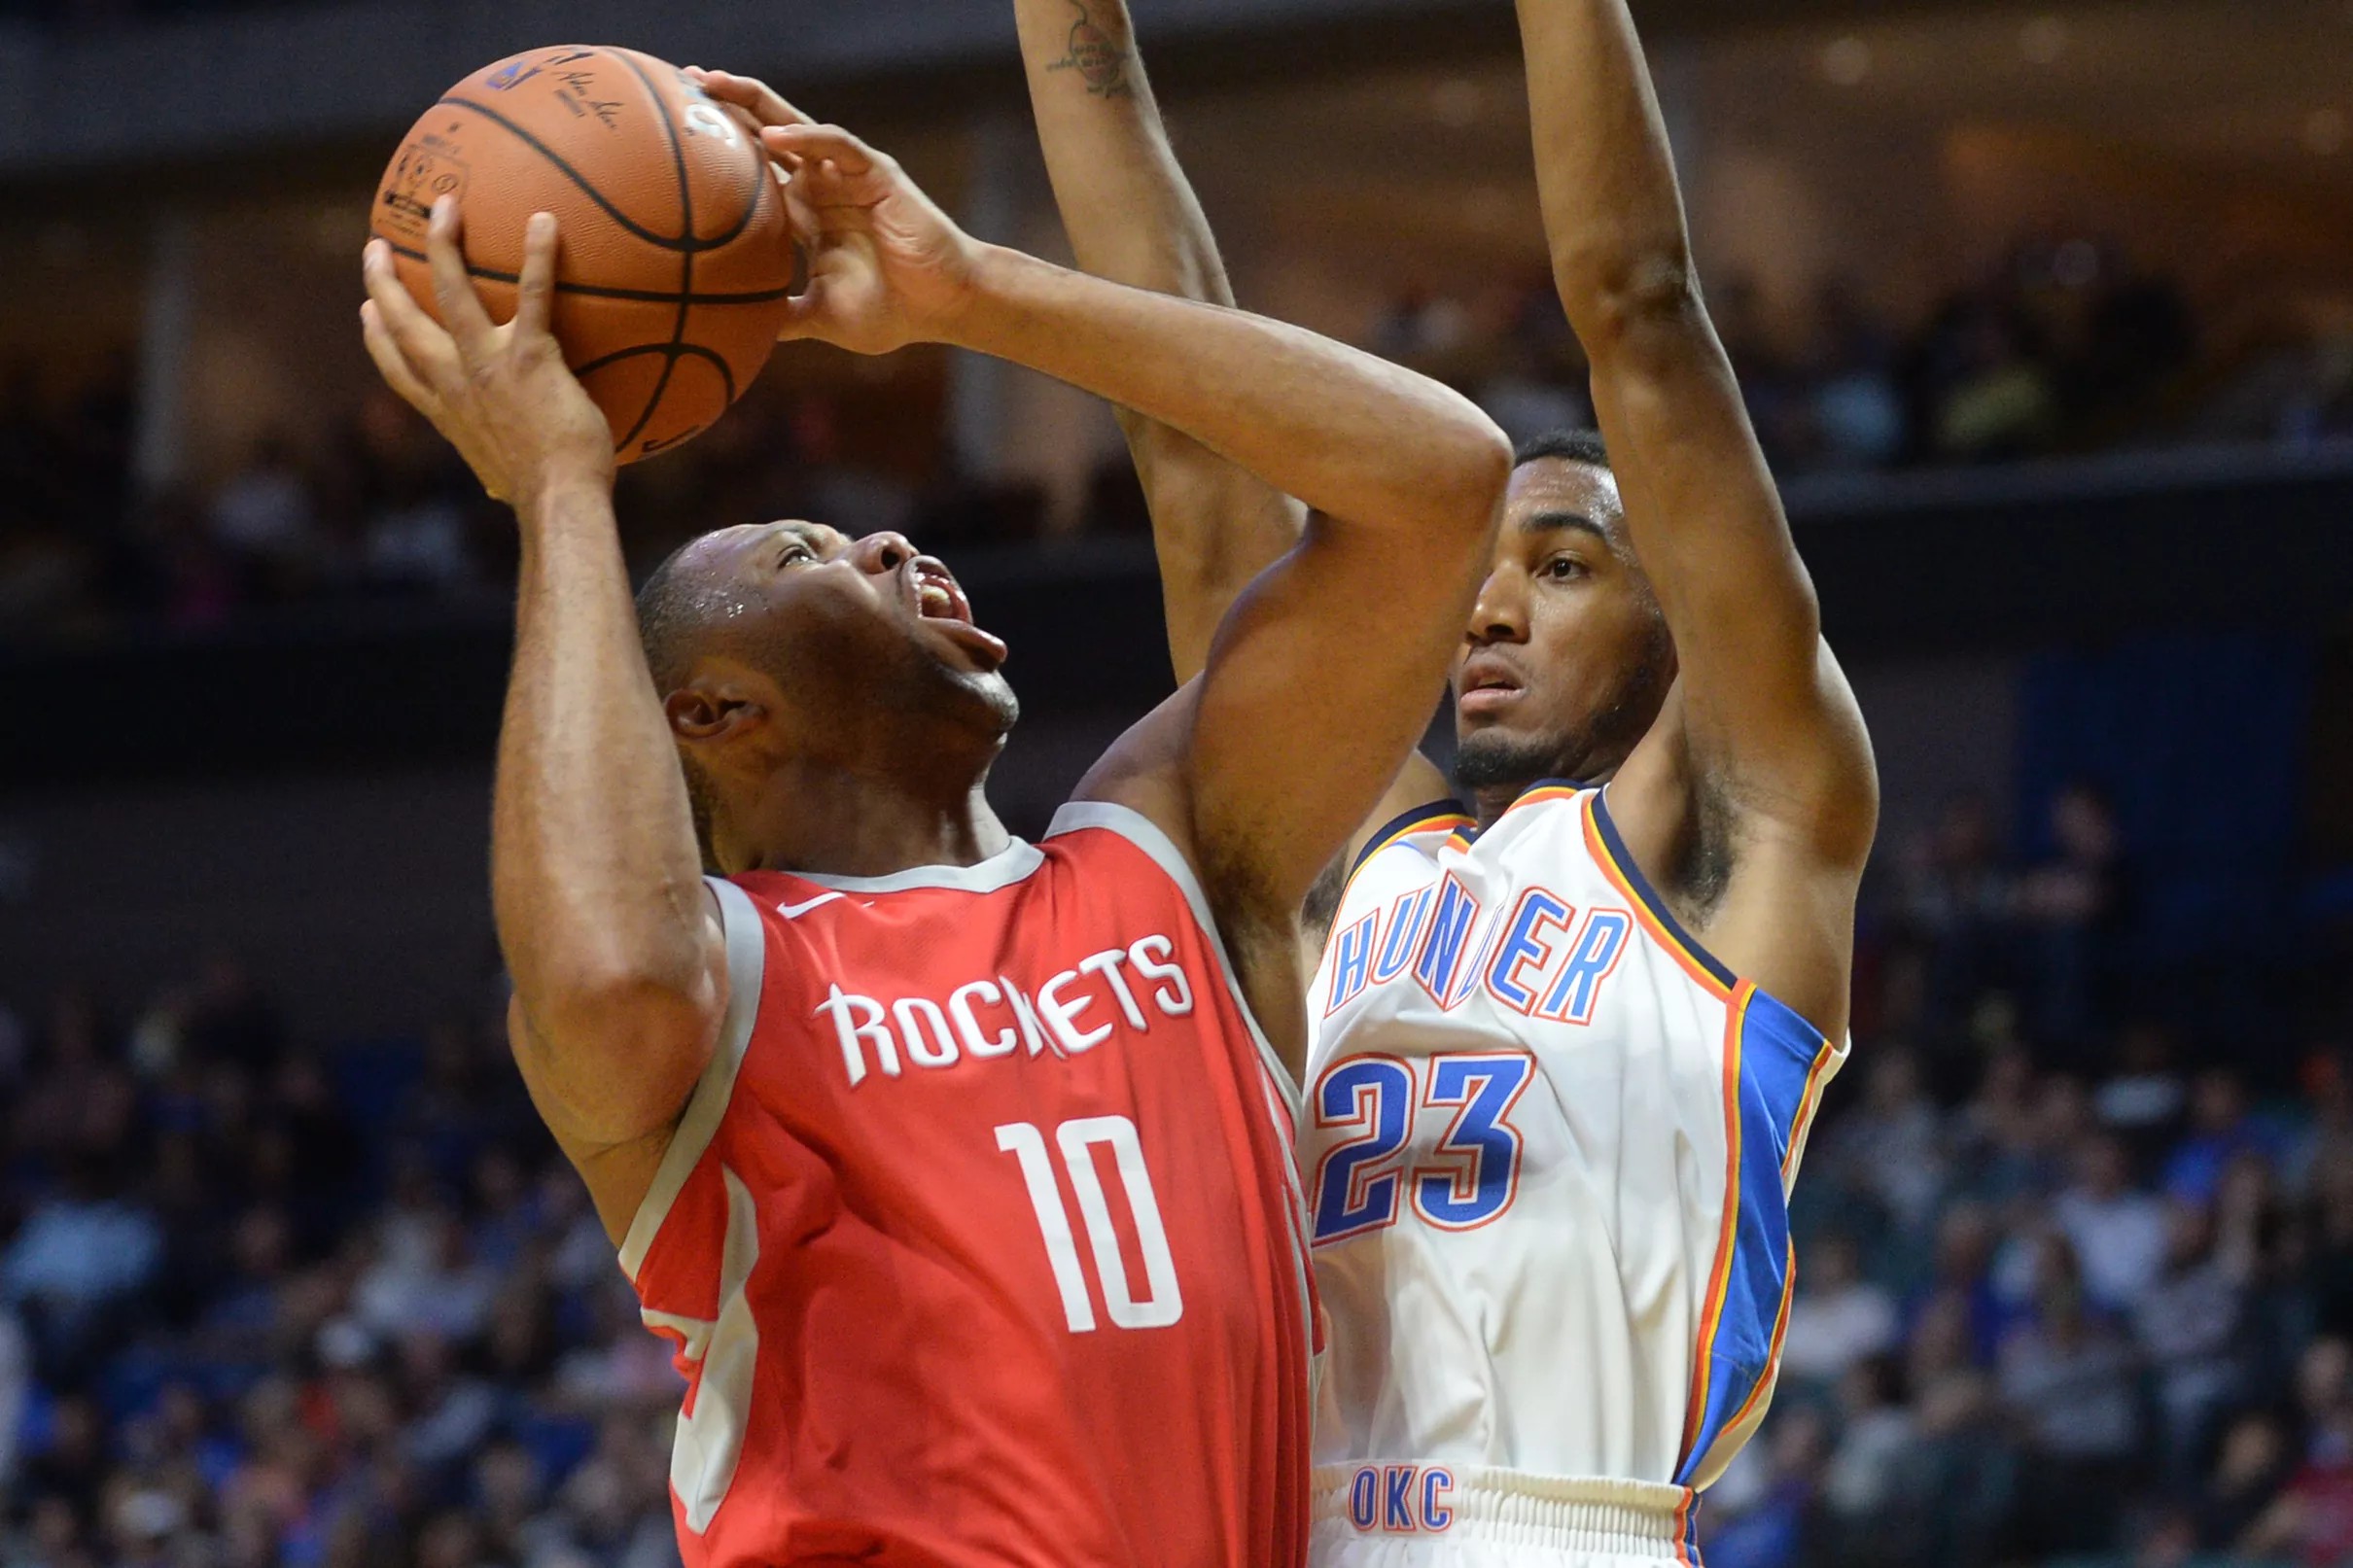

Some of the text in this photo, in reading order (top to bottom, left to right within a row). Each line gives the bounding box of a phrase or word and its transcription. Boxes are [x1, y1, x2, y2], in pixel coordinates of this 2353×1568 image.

[814, 934, 1193, 1087] ROCKETS
[994, 1115, 1183, 1333] 10
[1311, 1049, 1537, 1248] 23
[1349, 1466, 1455, 1533] OKC
